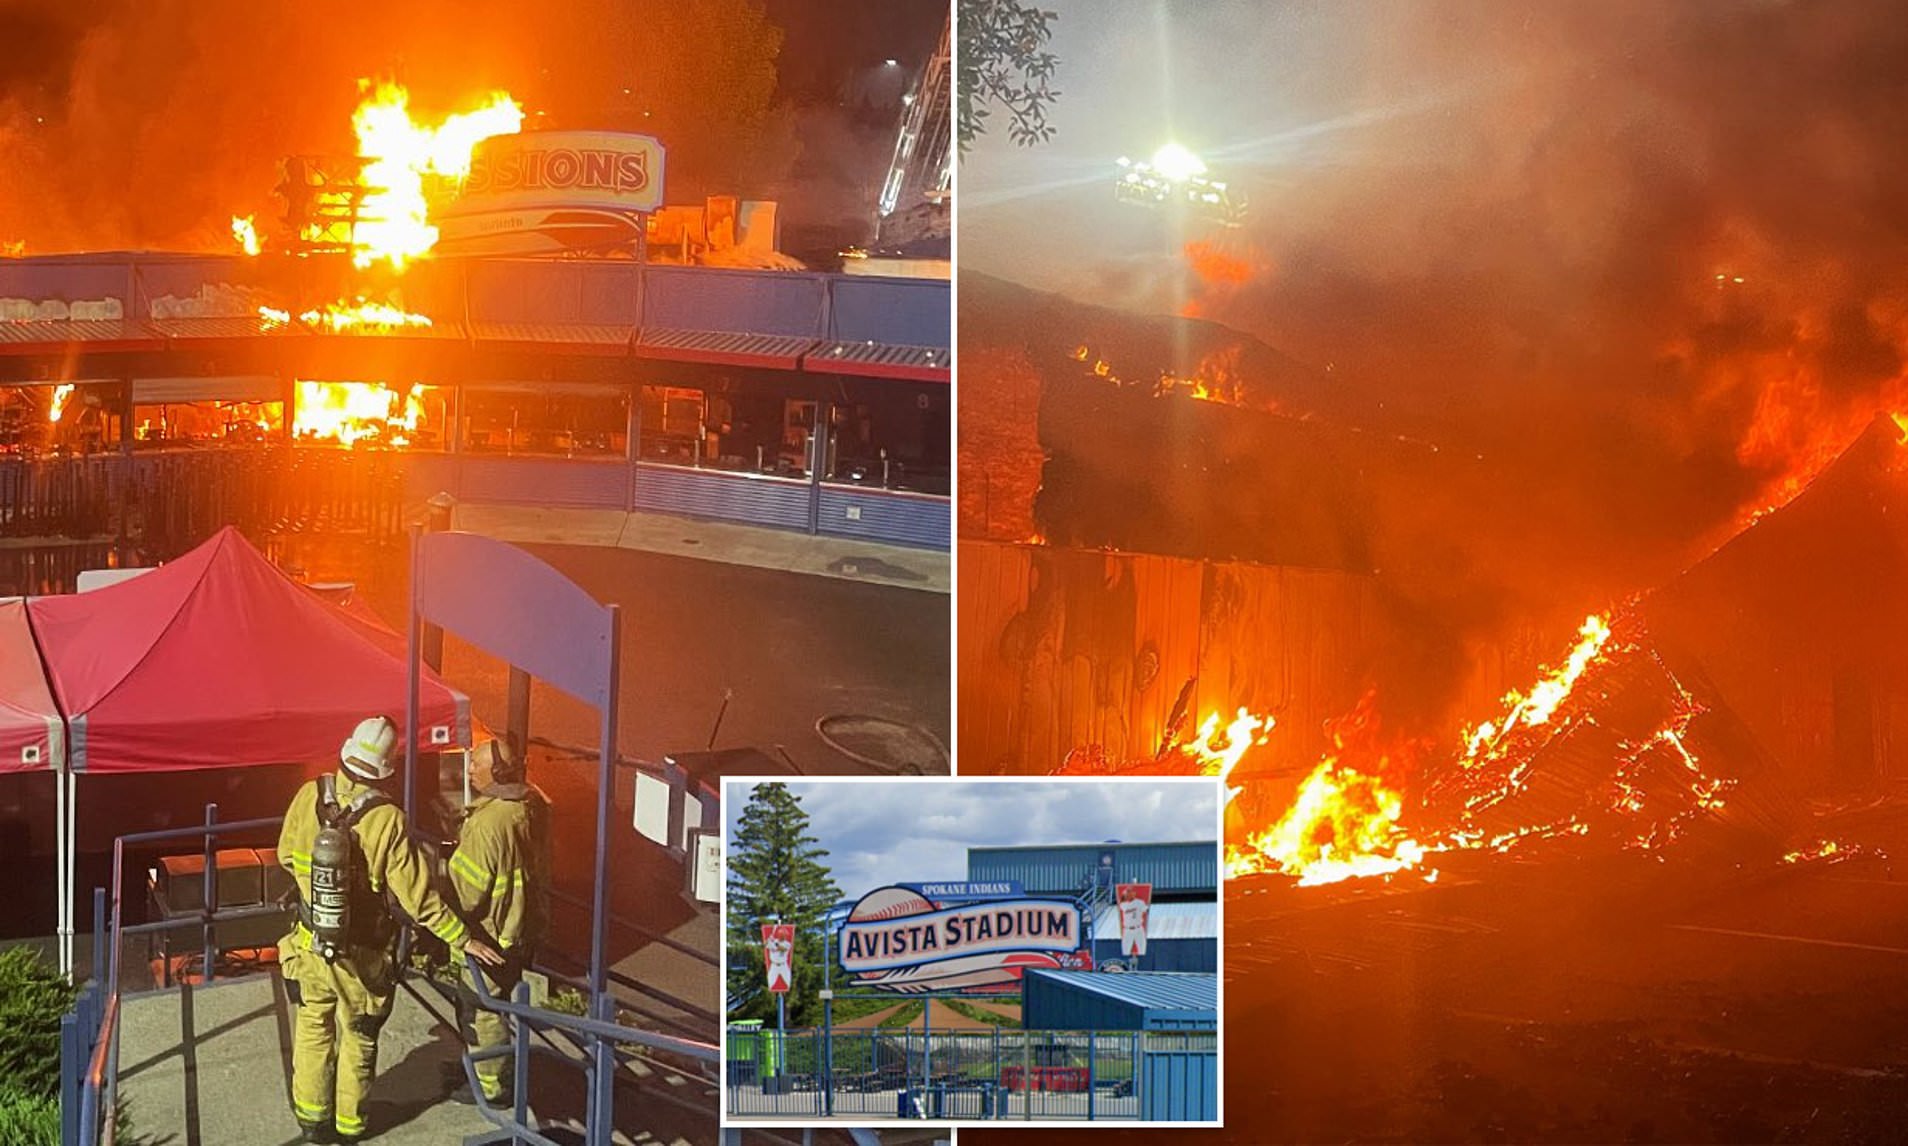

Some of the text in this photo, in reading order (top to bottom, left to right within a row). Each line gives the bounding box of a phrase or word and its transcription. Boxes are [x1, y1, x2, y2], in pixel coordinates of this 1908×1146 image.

[922, 882, 1011, 895] SPOKANE INDIANS
[846, 910, 1069, 959] AVISTA STADIUM
